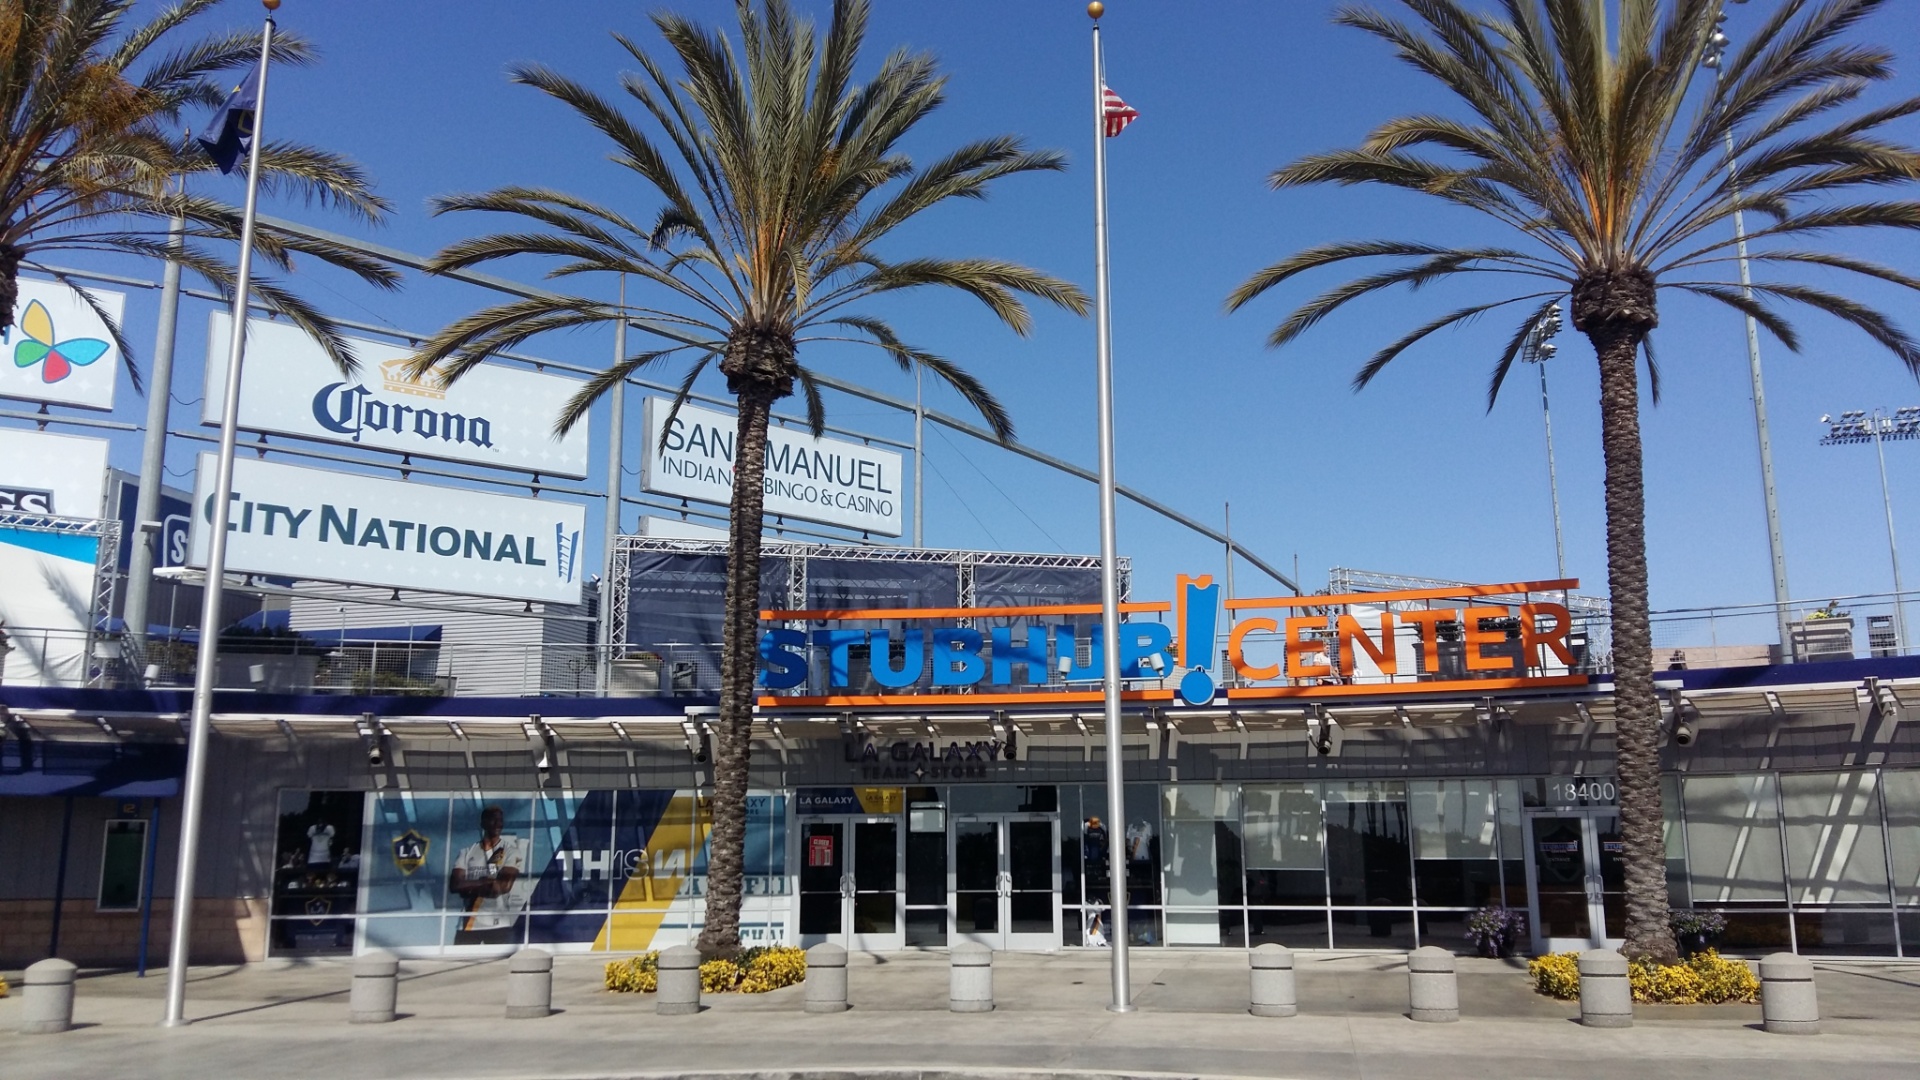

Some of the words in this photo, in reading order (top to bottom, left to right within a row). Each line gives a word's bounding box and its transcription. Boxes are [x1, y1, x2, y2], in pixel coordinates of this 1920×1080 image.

[312, 382, 494, 449] Corona
[664, 417, 733, 462] SAN
[765, 440, 893, 495] MANUEL
[663, 456, 731, 486] INDIAN
[765, 477, 817, 503] BINGO
[820, 489, 833, 507] &
[835, 491, 893, 517] CASINO
[318, 503, 547, 566] NATIONAL
[1228, 601, 1578, 681] CENTER
[845, 741, 879, 763] LA
[891, 741, 1001, 763] GALAXY
[861, 766, 909, 780] TEAM
[931, 765, 987, 779] STORE
[815, 796, 853, 805] GALAXY
[1552, 782, 1615, 801] 18400
[399, 845, 421, 858] LA
